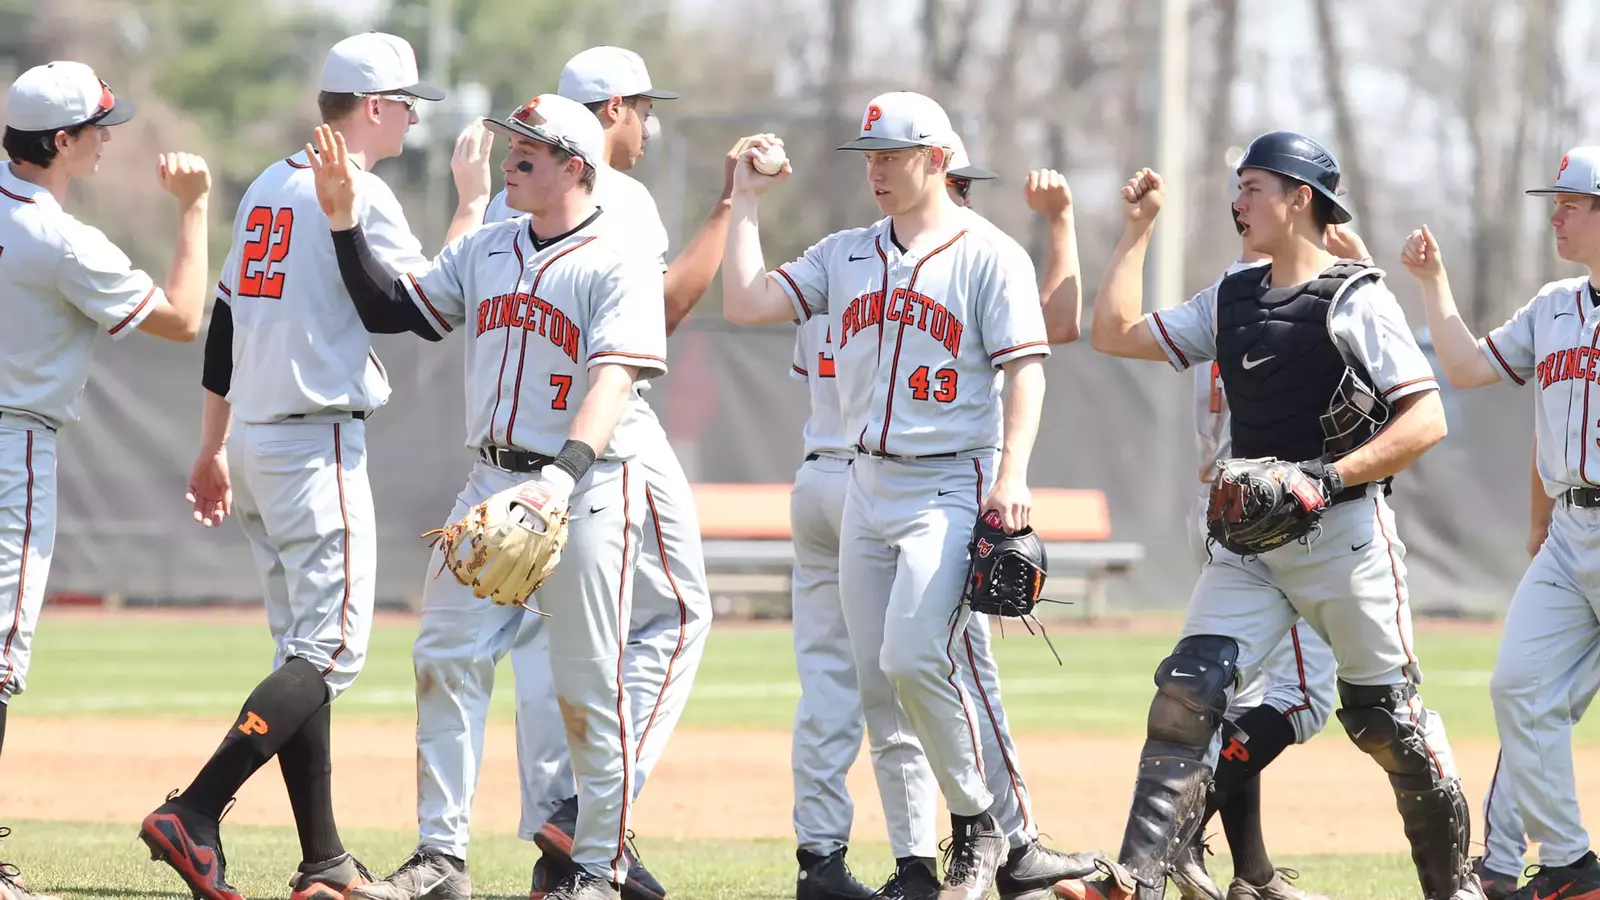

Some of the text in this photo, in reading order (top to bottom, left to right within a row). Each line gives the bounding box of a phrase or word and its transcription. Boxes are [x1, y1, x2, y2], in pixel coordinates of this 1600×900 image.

[863, 104, 882, 131] P
[238, 205, 294, 299] 22
[476, 292, 580, 364] RINCETON
[840, 287, 963, 359] PRINCETON
[908, 365, 958, 403] 43
[1536, 346, 1600, 391] PRINCE
[550, 374, 572, 410] 7
[238, 711, 268, 735] P
[1220, 736, 1250, 761] P
